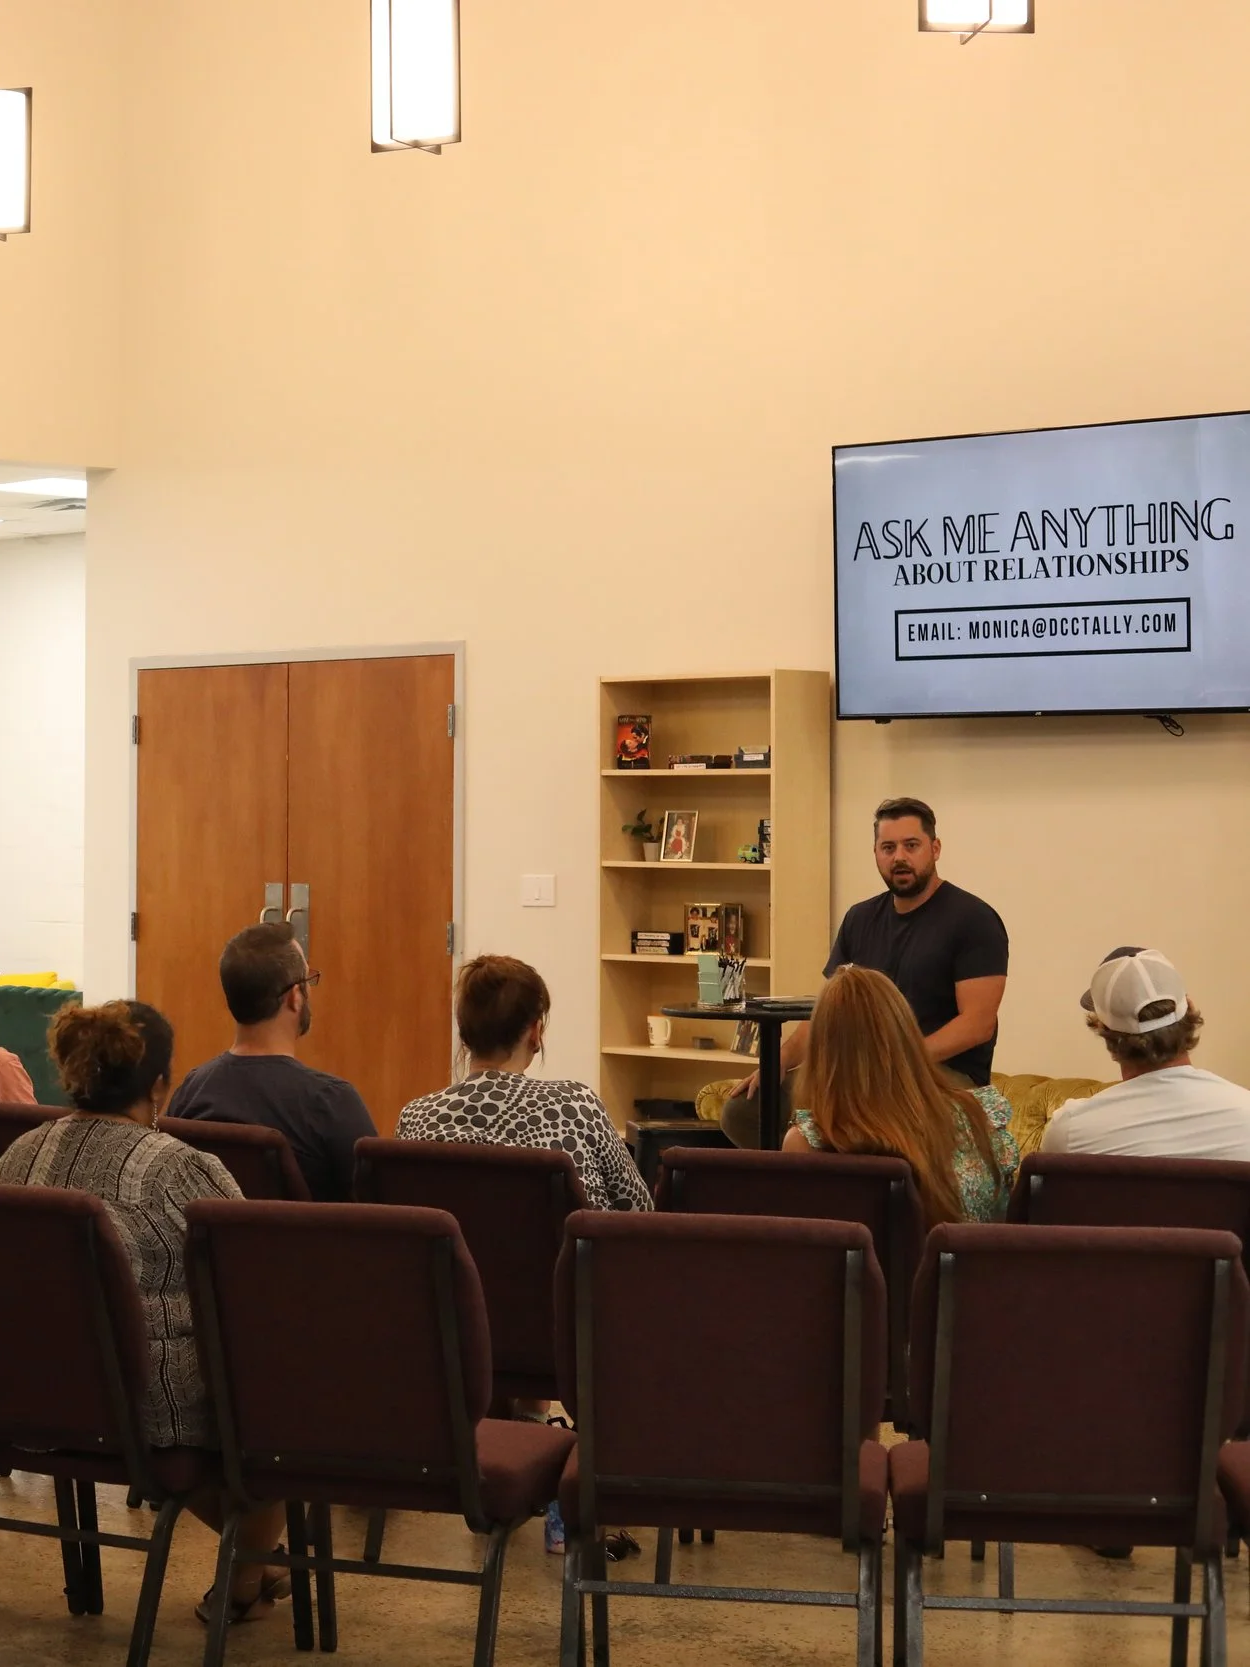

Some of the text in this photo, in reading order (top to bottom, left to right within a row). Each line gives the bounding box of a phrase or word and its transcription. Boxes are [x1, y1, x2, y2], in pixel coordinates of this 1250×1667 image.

[853, 497, 1234, 562] ASK ME ANYTHING
[893, 548, 1190, 587] ABOUT RELATIONSHIPS
[907, 612, 1177, 642] EMAIL: MONICA@DCCTALLY.COM
